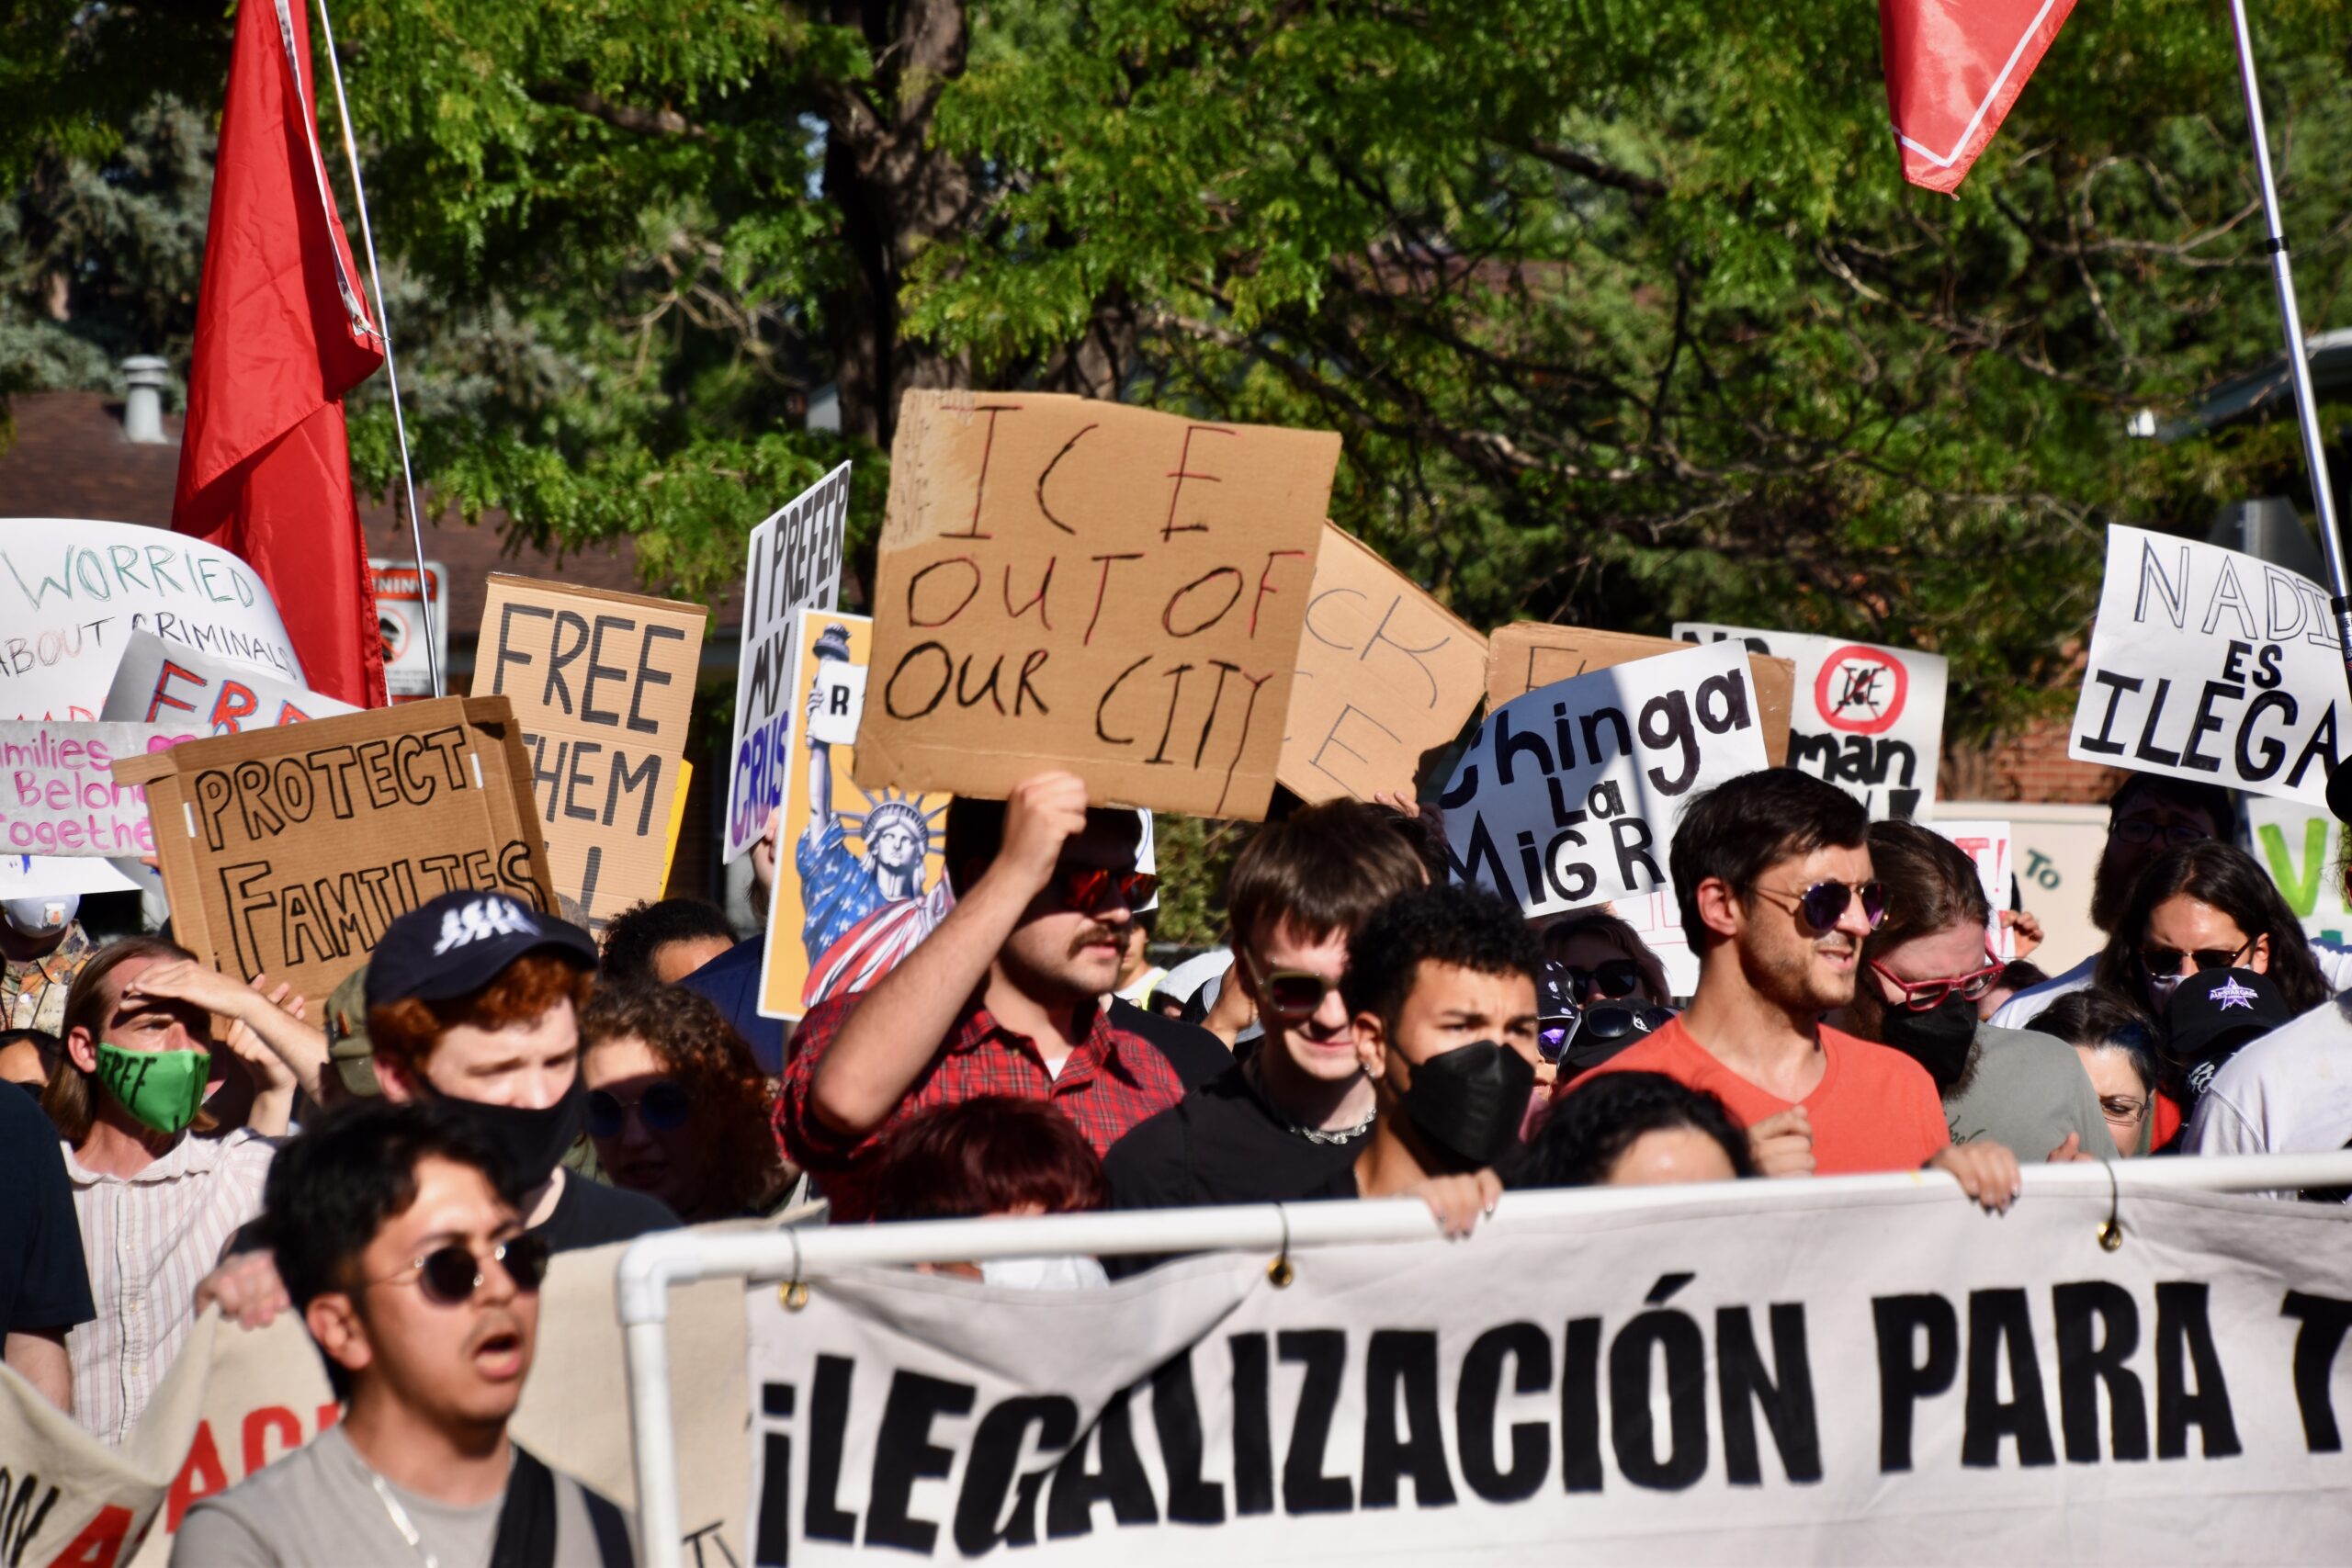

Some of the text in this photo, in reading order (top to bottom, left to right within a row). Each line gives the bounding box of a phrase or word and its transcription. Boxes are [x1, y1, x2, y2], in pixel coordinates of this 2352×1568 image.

[939, 405, 1243, 543] ICE
[0, 544, 254, 613] WORRIED
[750, 467, 850, 641] I PREFER
[908, 551, 1306, 647] OUT OF
[2134, 536, 2342, 650] NADI
[492, 603, 685, 735] FREE
[742, 622, 791, 738] MY
[1306, 588, 1450, 710] CK
[2222, 639, 2283, 689] ES
[0, 729, 115, 772] milies
[523, 733, 662, 836] HEM
[732, 709, 789, 847] CRUS
[885, 640, 1275, 816] OUR CITY
[1786, 728, 1917, 788] man
[2080, 669, 2340, 789] ILEGA
[0, 813, 156, 854] ogethe
[195, 725, 467, 852] PROTECT
[1547, 779, 1626, 828] La
[1446, 809, 1667, 916] MiGR
[100, 1051, 158, 1115] FREE
[1871, 1280, 2243, 1472] PARA
